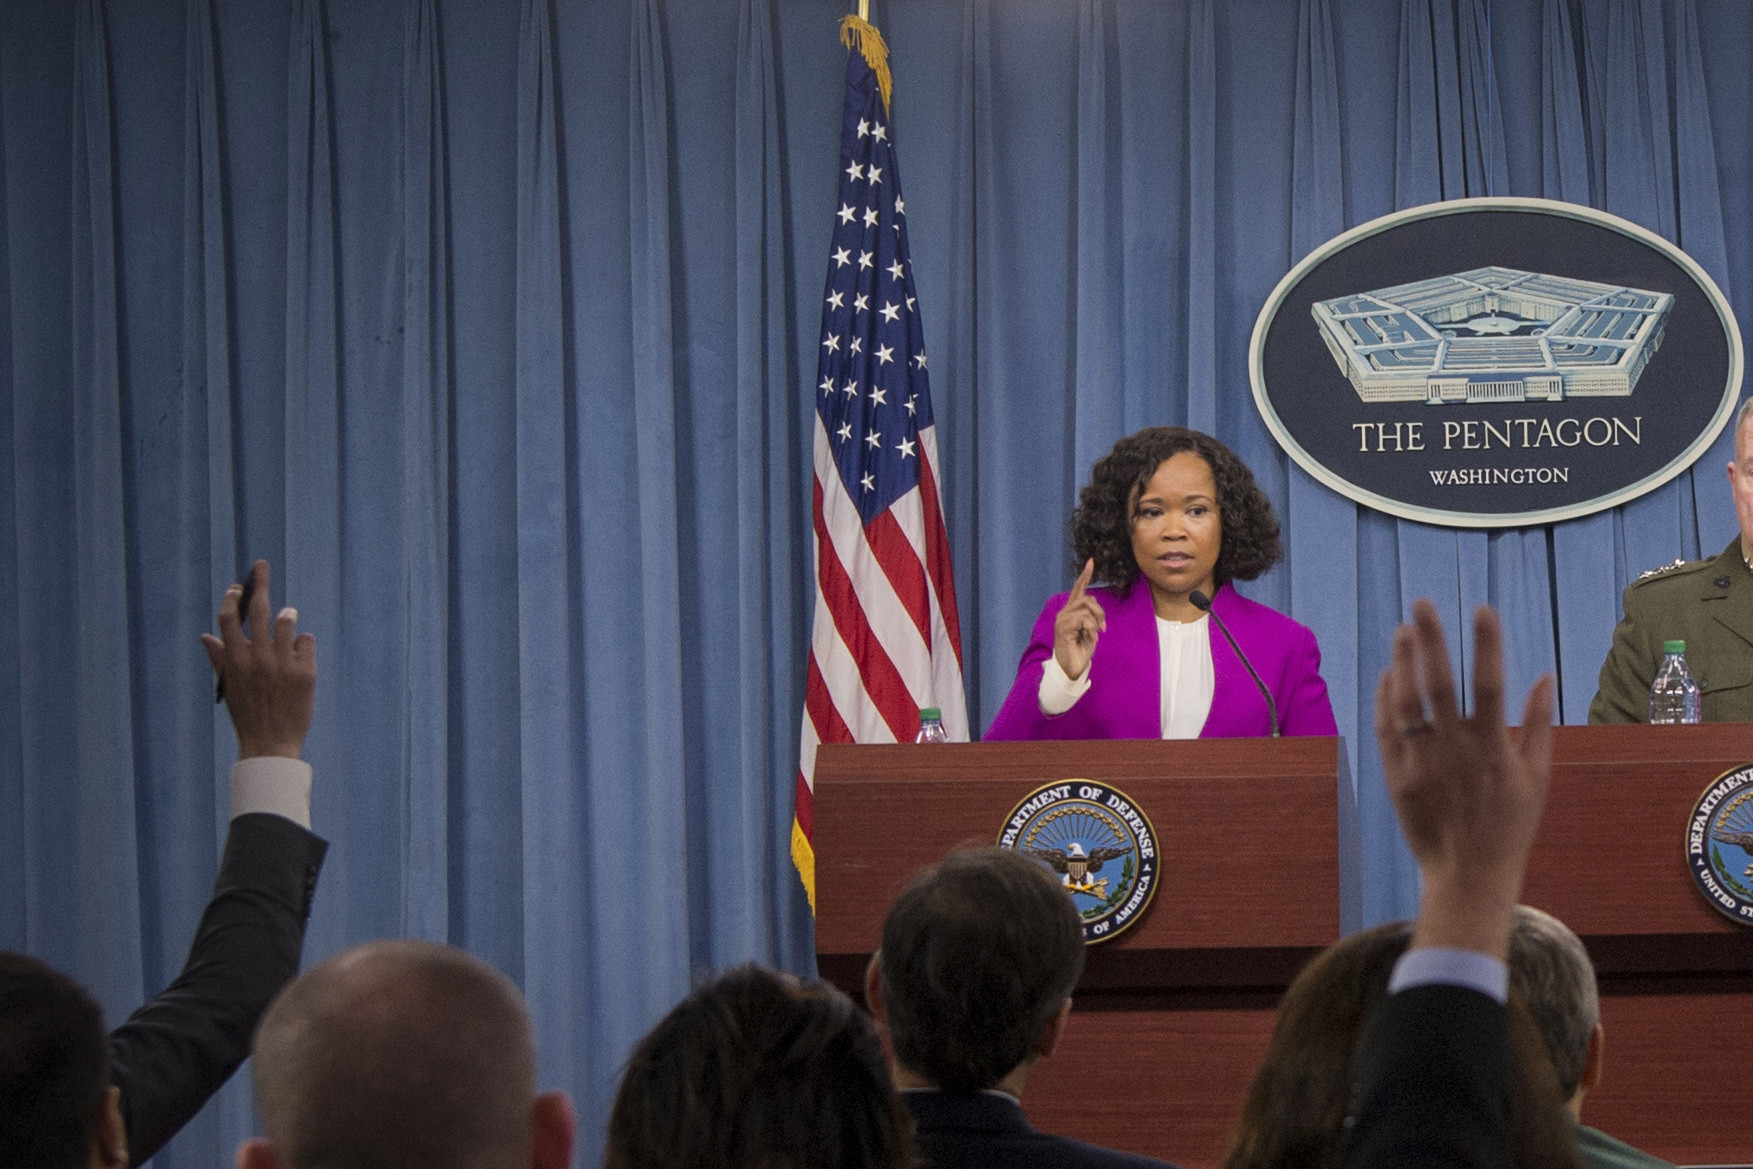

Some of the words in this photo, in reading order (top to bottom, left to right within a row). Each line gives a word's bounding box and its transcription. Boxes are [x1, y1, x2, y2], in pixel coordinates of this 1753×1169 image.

[1352, 422, 1425, 452] THE
[1443, 417, 1642, 450] PENTAGON
[1429, 467, 1569, 486] WASHINGTON
[1079, 786, 1103, 800] OF
[1106, 794, 1154, 859] DEFENSE
[1093, 921, 1110, 934] OF
[1115, 875, 1150, 925] AMERICA
[1700, 869, 1736, 909] UNITED
